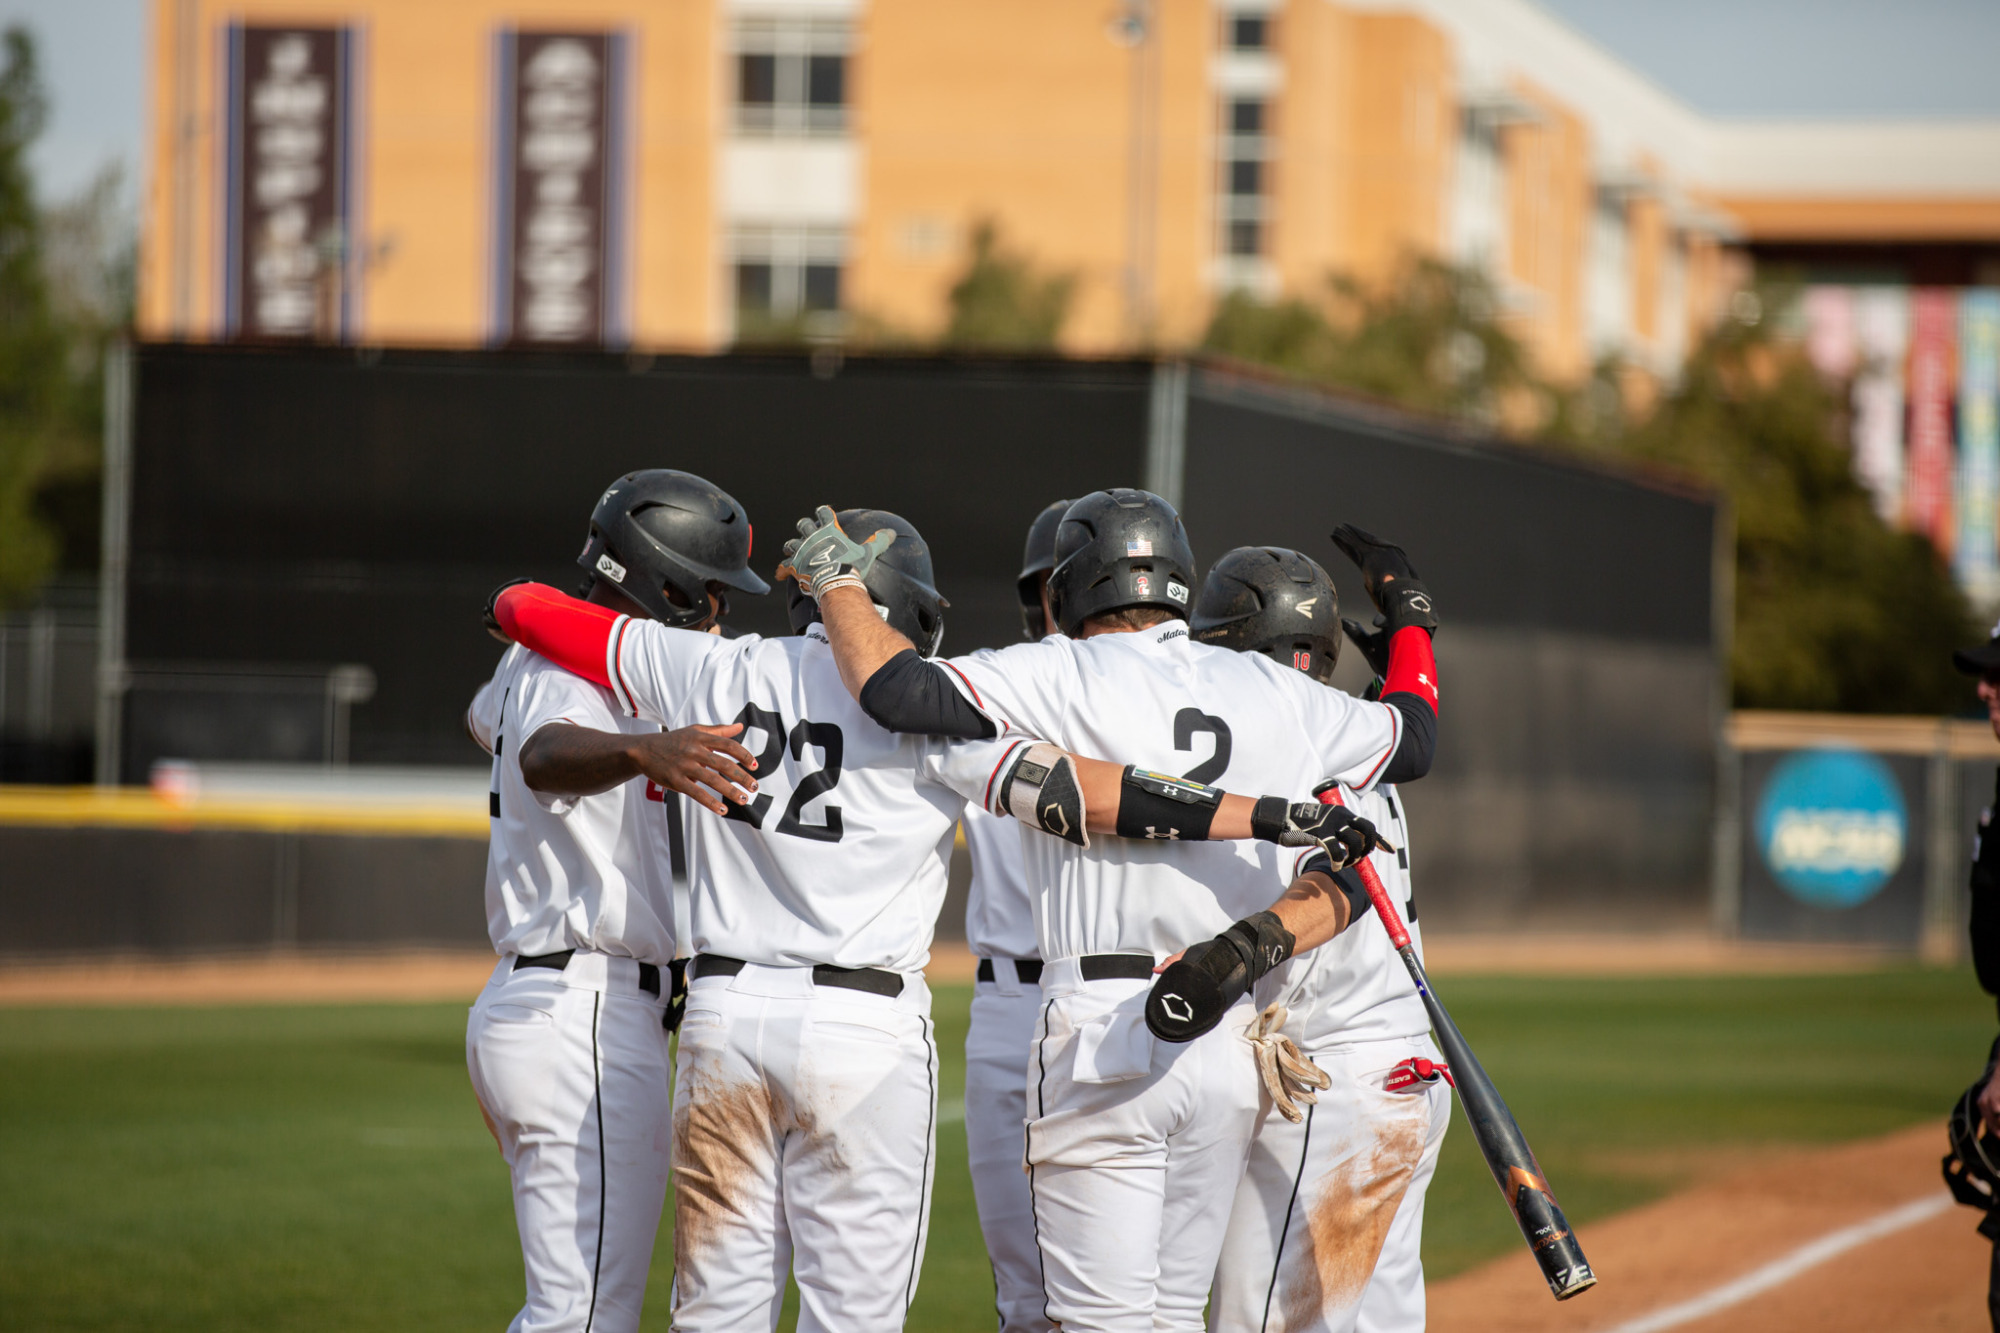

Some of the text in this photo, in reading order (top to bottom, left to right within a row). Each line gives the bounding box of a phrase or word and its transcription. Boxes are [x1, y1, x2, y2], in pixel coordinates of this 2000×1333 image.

[1137, 576, 1150, 596] 2
[1293, 651, 1311, 671] 10
[1173, 707, 1232, 787] 2
[718, 701, 844, 844] 22
